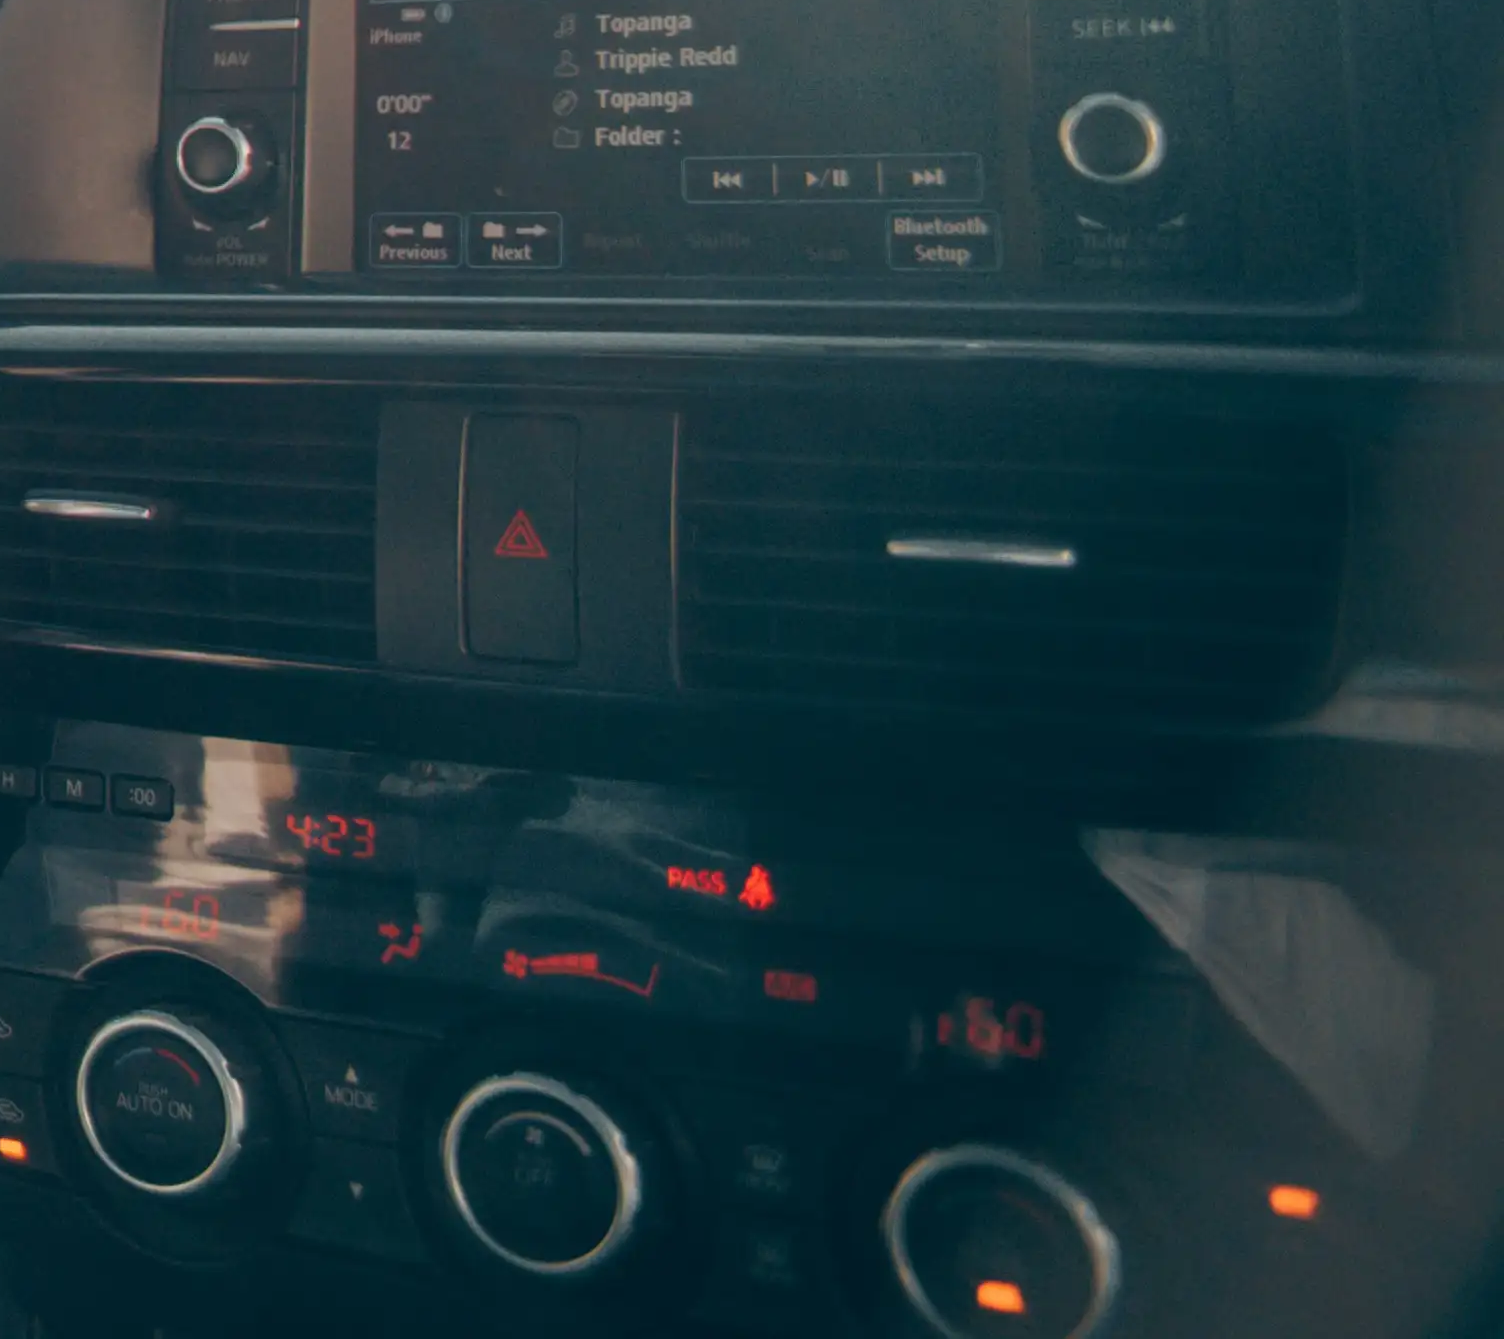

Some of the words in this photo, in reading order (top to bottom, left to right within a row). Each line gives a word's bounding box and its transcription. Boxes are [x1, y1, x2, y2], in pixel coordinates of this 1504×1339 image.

[369, 26, 423, 45] iPhone
[593, 12, 694, 39] Topanga
[1070, 17, 1135, 42] SEEK
[213, 48, 252, 69] NAV
[593, 46, 674, 75] Trippie
[678, 43, 739, 69] Redd
[593, 88, 694, 114] Topanga
[386, 129, 412, 152] 12
[593, 124, 667, 147] Folder
[891, 215, 992, 238] Bluetooth
[378, 241, 448, 261] Previous
[491, 242, 533, 261] Next
[912, 242, 975, 268] Setup
[0, 769, 17, 789] H
[64, 776, 85, 799] M
[127, 784, 157, 807] :00
[284, 812, 376, 860] 4:23
[667, 864, 727, 898] PASS
[116, 1091, 163, 1117] AUTO
[167, 1098, 194, 1121] ON
[323, 1082, 381, 1113] MODE
